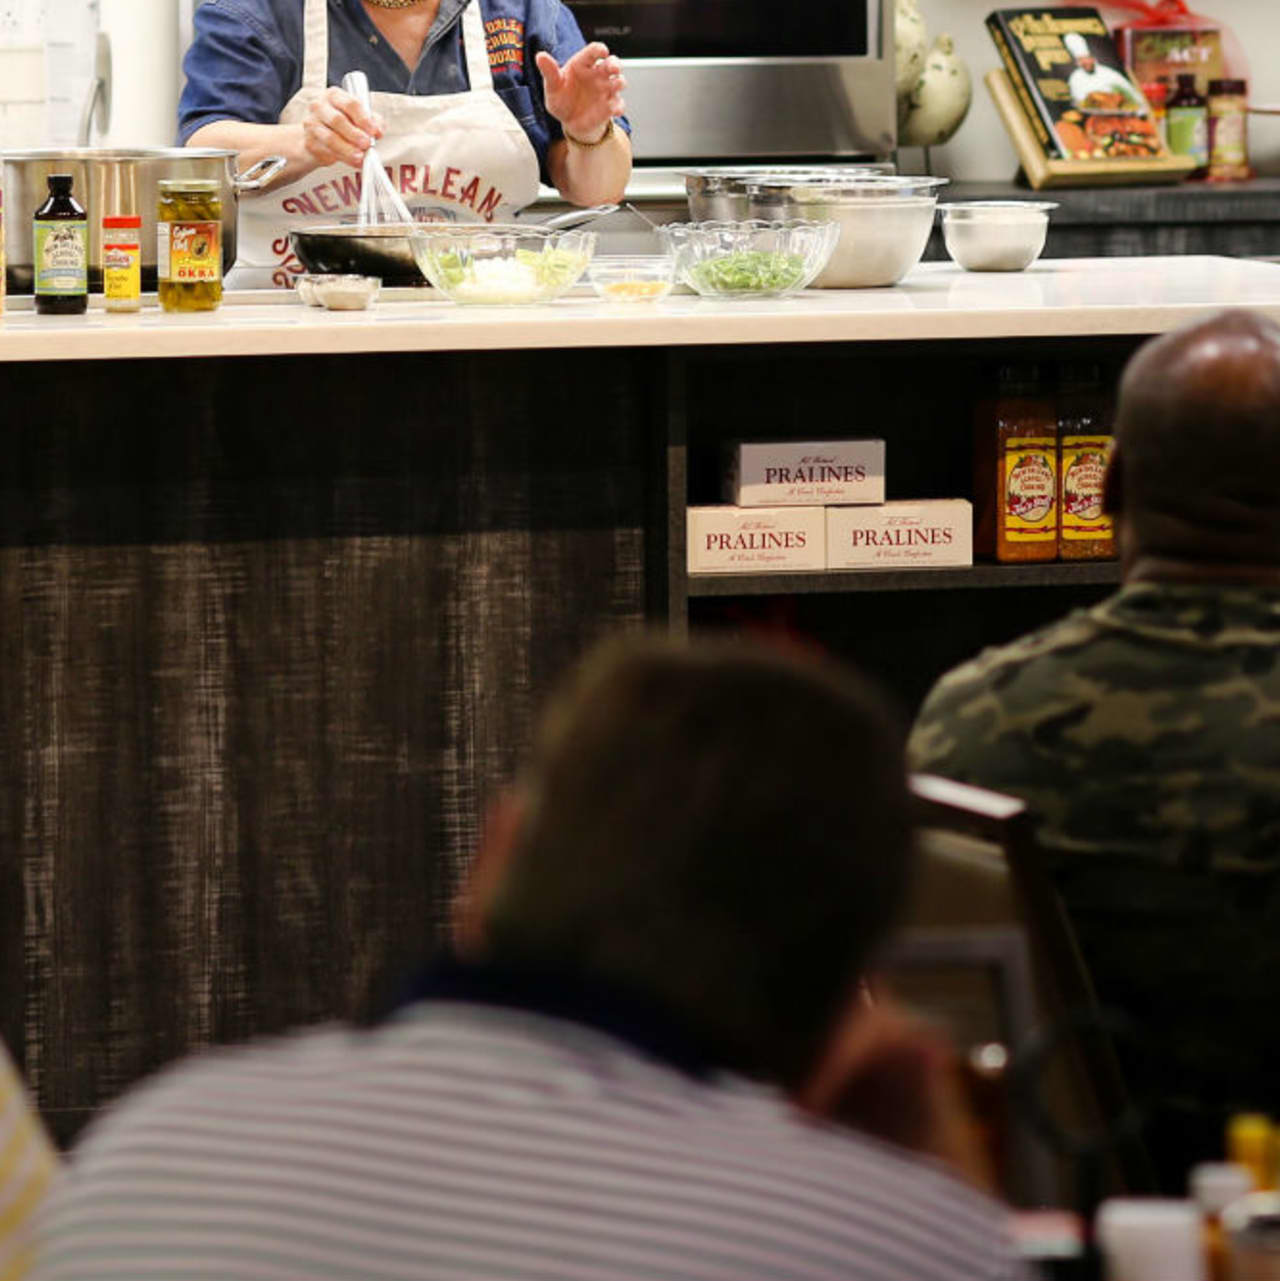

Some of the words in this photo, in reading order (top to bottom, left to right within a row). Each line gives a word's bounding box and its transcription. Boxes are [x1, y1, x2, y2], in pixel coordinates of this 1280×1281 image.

[281, 171, 363, 216] NEW
[765, 465, 867, 485] PRALINES
[706, 531, 807, 550] PRALINES
[851, 527, 953, 547] PRALINES
